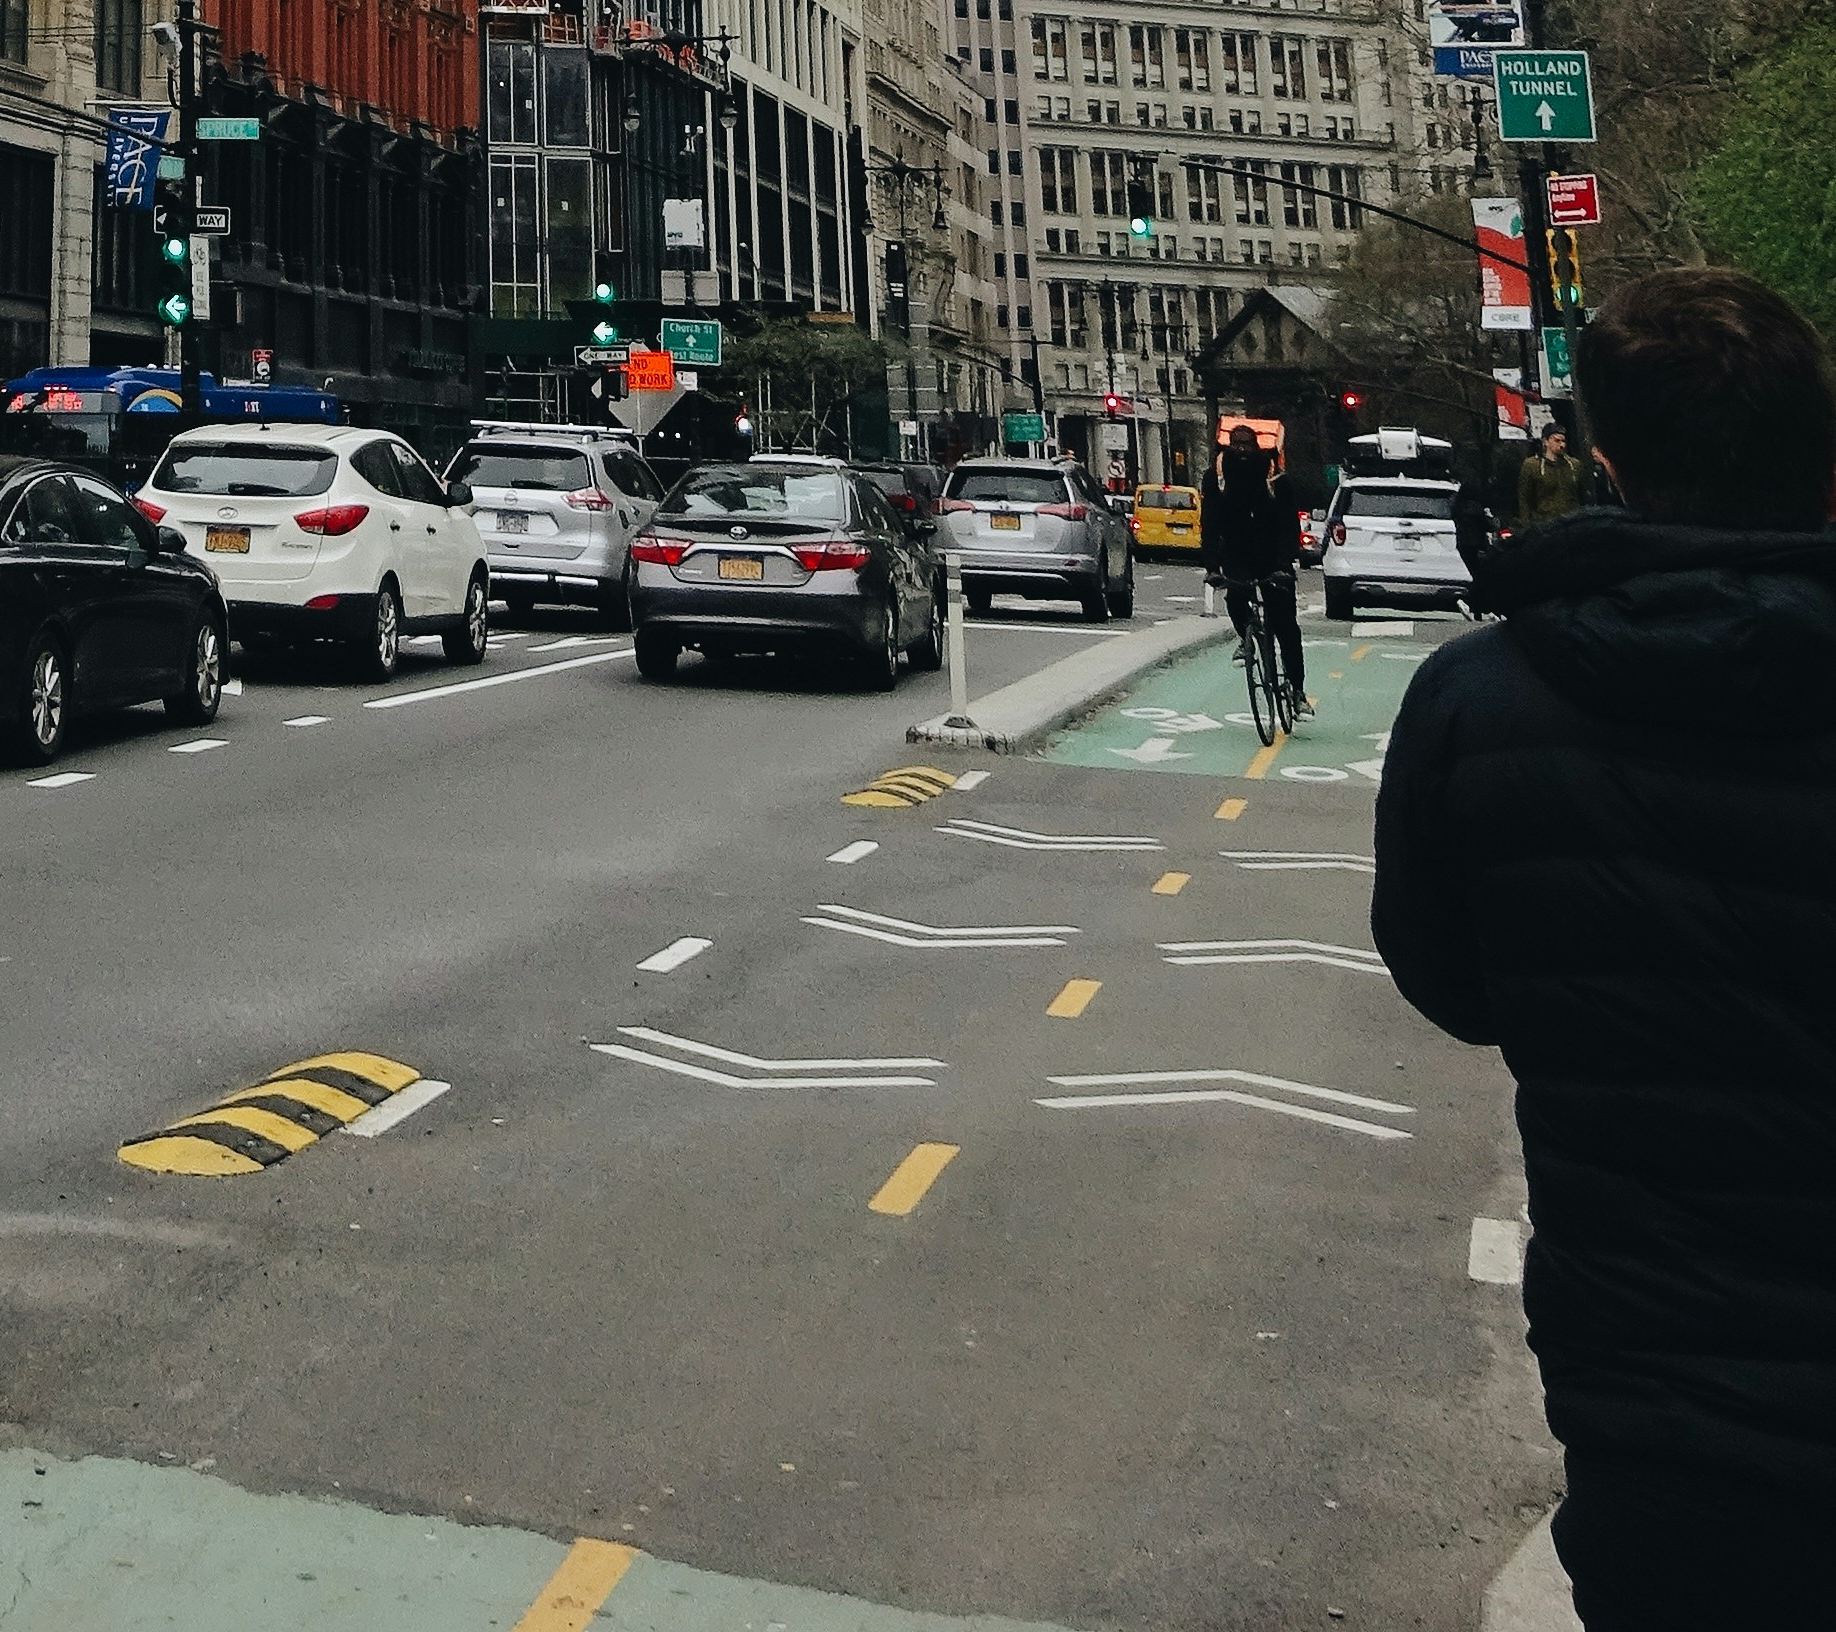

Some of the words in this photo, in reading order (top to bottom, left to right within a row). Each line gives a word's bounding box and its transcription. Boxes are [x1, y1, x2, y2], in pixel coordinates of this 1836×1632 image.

[1501, 60, 1582, 76] HOLLAND
[1509, 80, 1578, 97] TUNNEL
[199, 215, 223, 226] WAY
[639, 373, 668, 386] WORK
